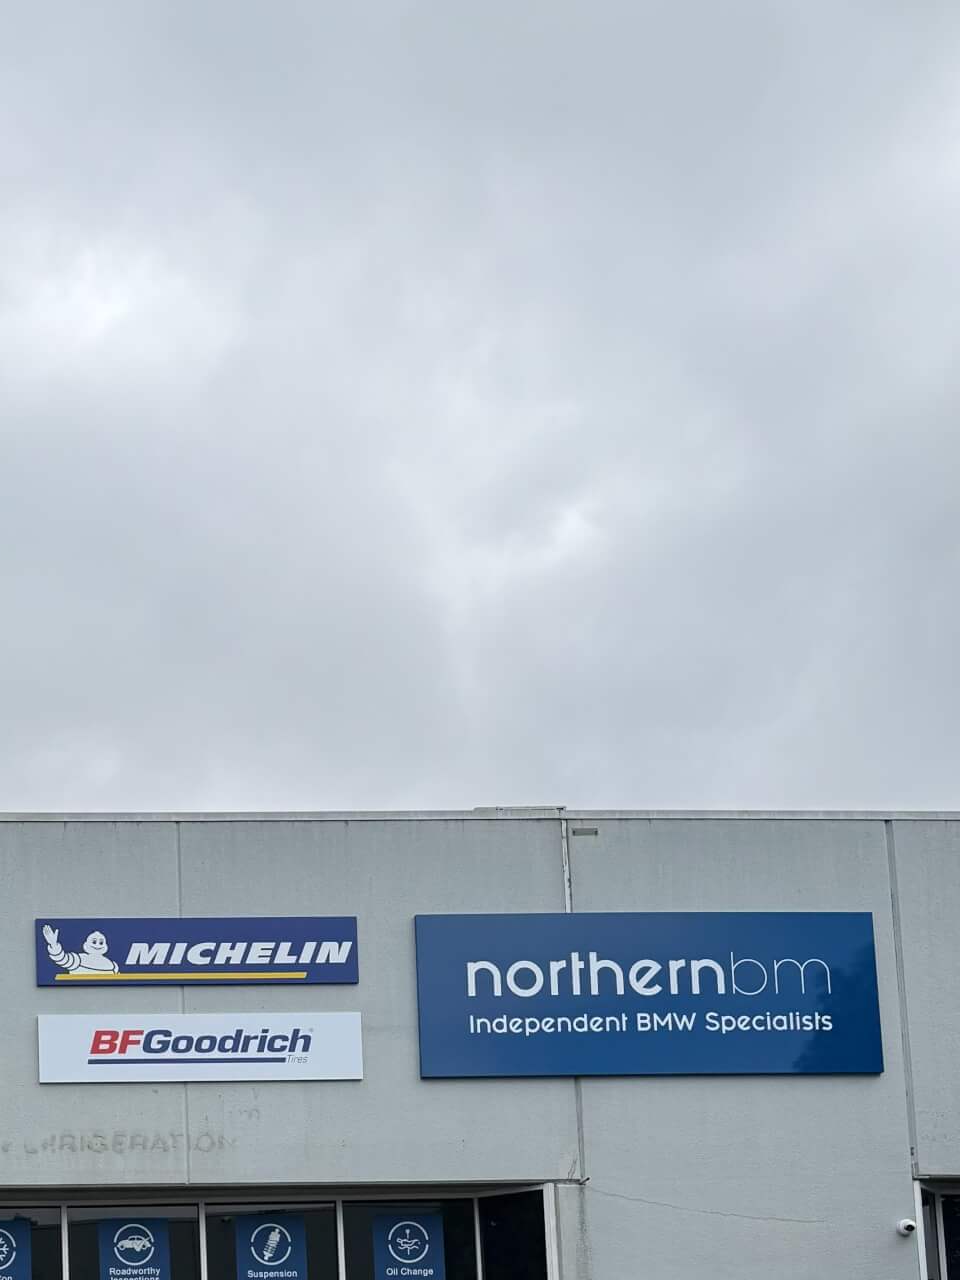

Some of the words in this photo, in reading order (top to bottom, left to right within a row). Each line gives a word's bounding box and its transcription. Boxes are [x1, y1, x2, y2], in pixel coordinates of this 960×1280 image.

[125, 940, 352, 966] MICHELIN
[469, 1013, 628, 1037] Independent
[637, 1012, 697, 1032] BMW
[705, 1011, 833, 1034] Specialists
[90, 1028, 312, 1055] BFGoodrich
[287, 1054, 309, 1064] Tires
[109, 1267, 161, 1278] Roadworthy
[247, 1269, 298, 1279] Suspension
[385, 1267, 396, 1276] Oil
[398, 1267, 434, 1278] Change
